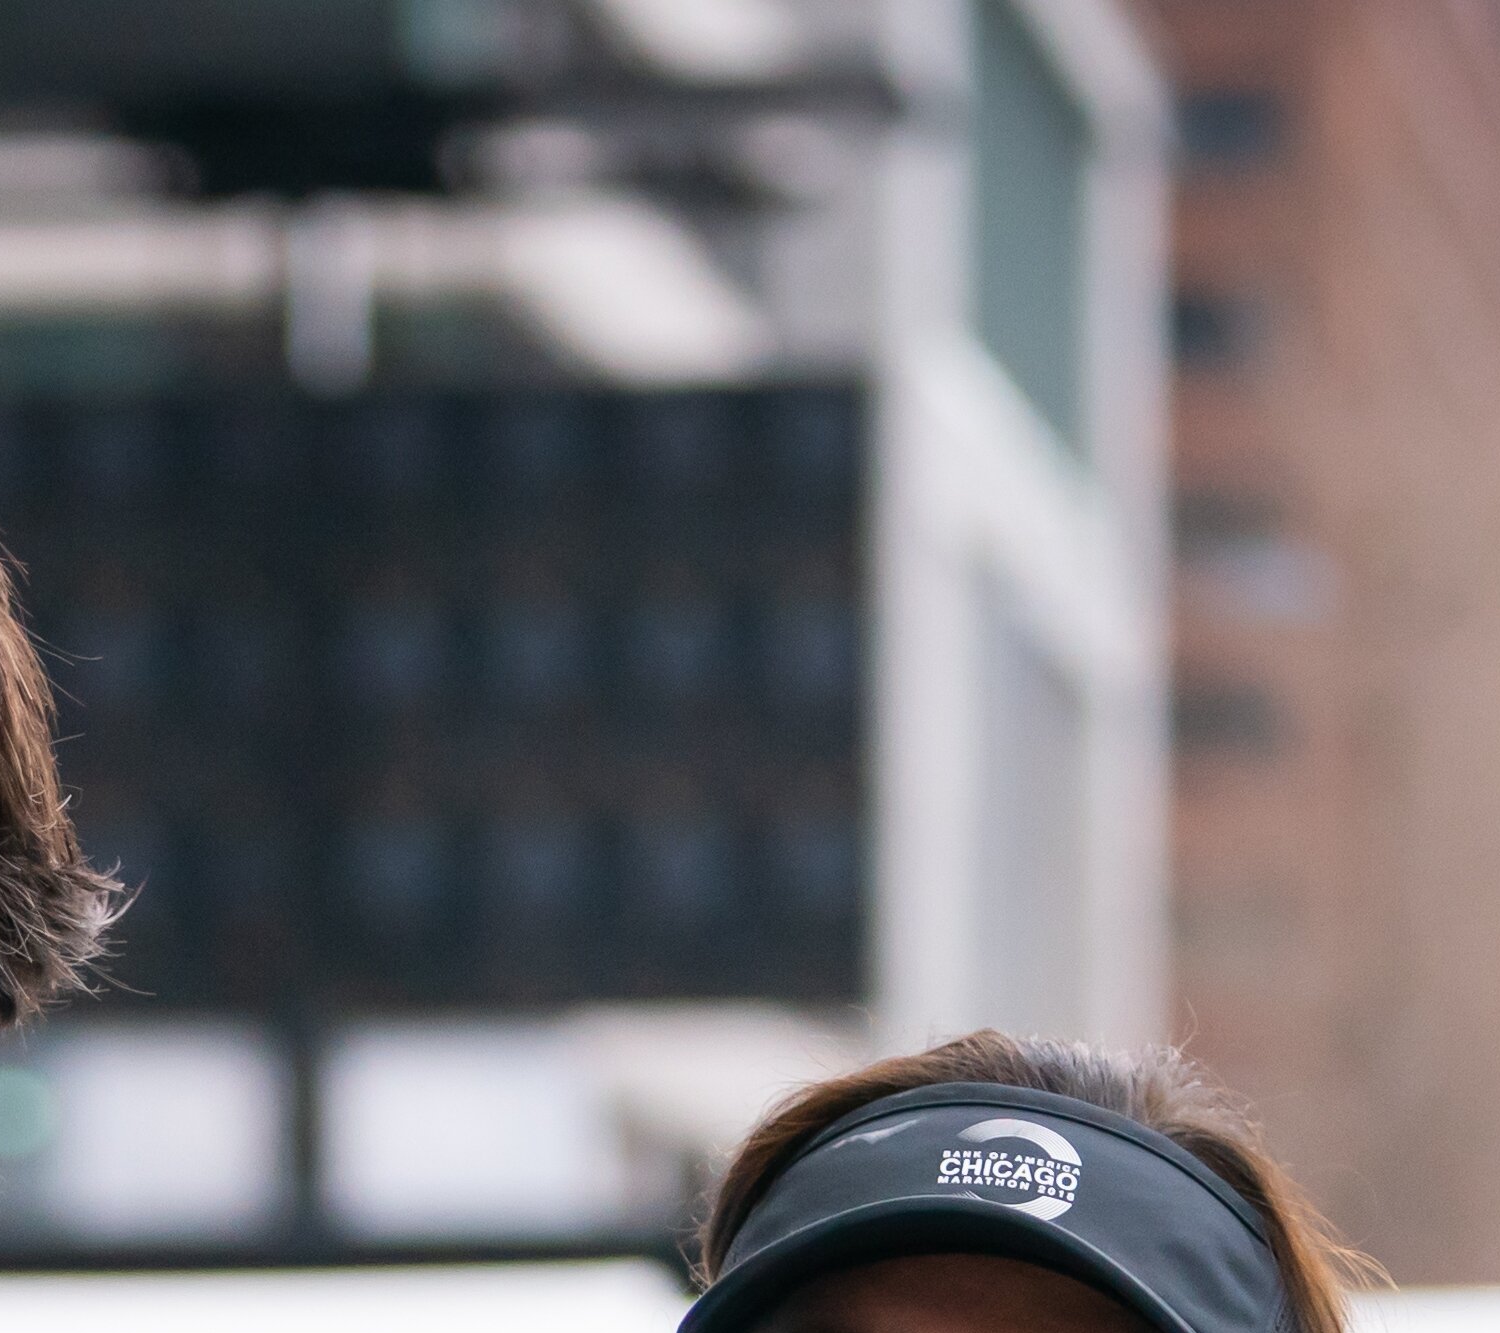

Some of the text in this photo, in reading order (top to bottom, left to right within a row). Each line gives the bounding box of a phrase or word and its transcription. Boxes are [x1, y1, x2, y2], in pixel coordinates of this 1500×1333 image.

[939, 1157, 1078, 1191] CHICAGO
[942, 1150, 1081, 1176] BANK OF AMERICA
[937, 1175, 1030, 1191] MARATHON
